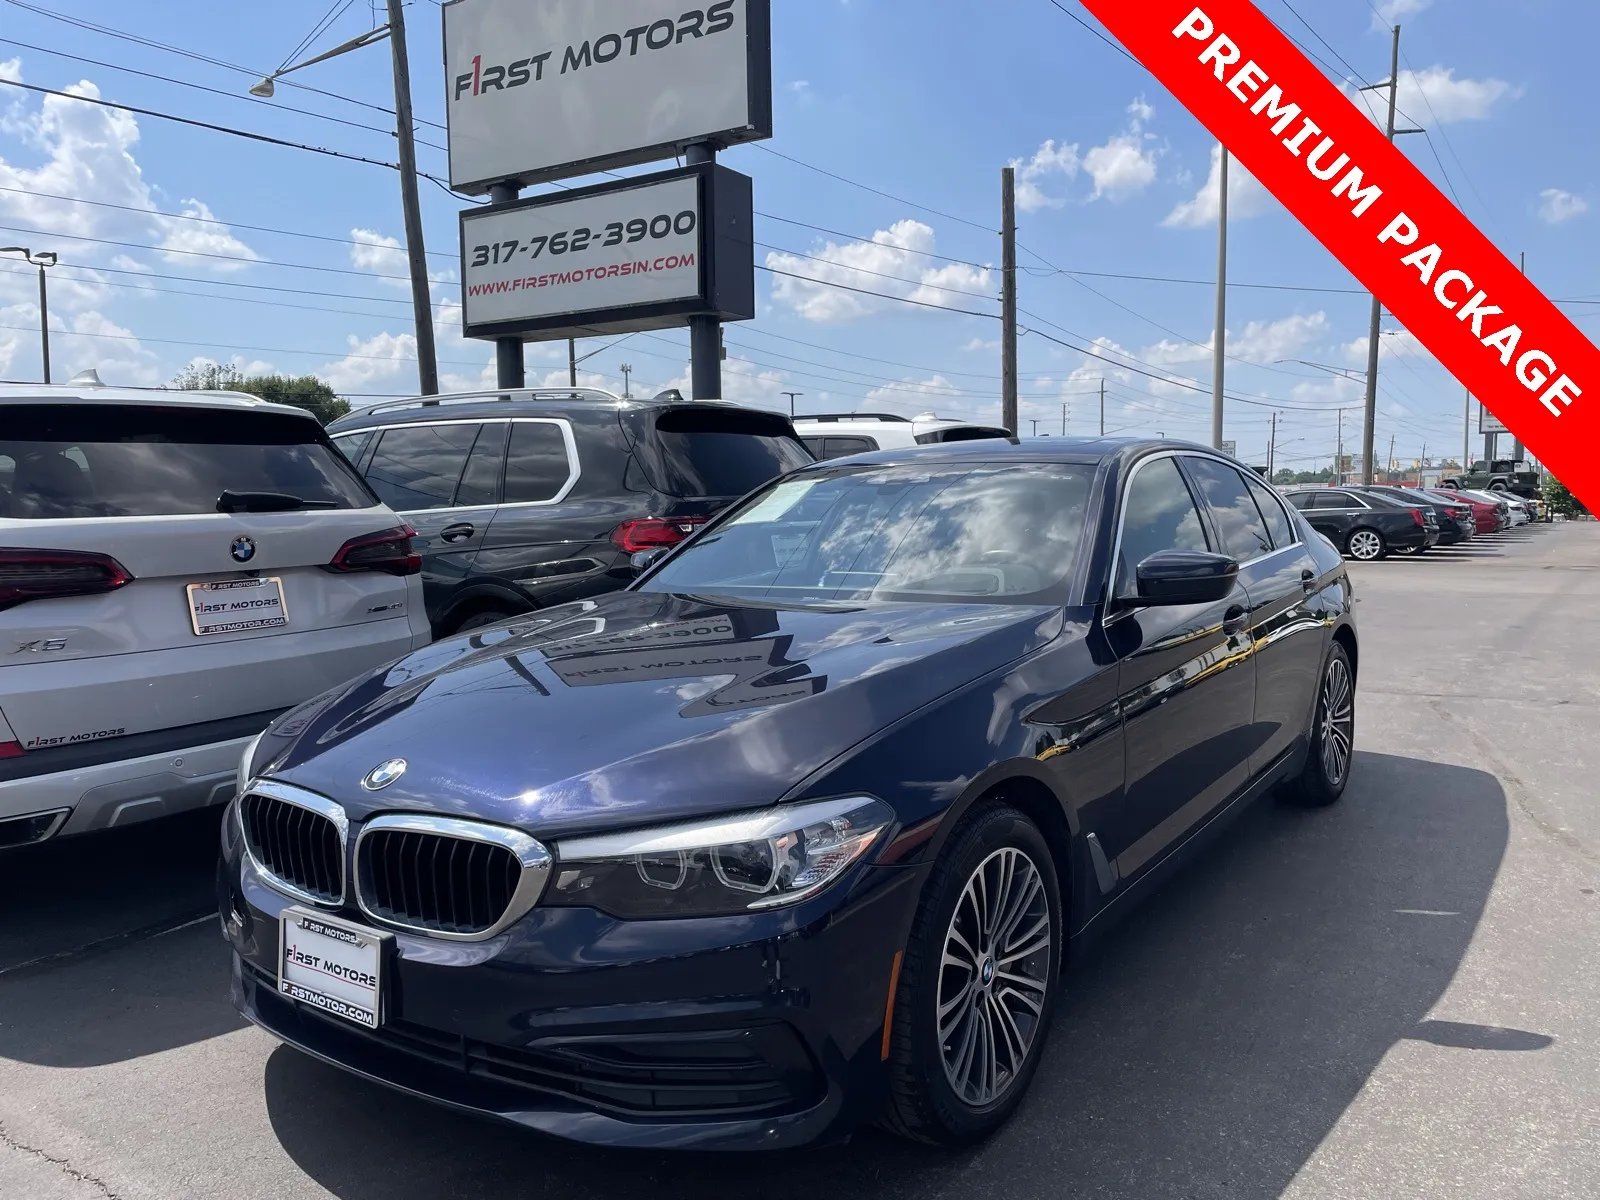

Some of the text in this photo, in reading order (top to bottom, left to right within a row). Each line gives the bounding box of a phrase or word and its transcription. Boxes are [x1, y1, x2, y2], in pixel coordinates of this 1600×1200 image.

[560, 0, 735, 75] MOTORS
[471, 210, 696, 268] 317-762-3900
[468, 253, 695, 297] WWW.FIRSTMOTORSIN.COM
[232, 580, 260, 588] MOTORS
[230, 598, 279, 609] MOTORS
[12, 638, 68, 655] X5
[69, 727, 125, 742] MOTORS
[304, 920, 356, 943] FRST MOTORS
[323, 960, 376, 987] MOTORS
